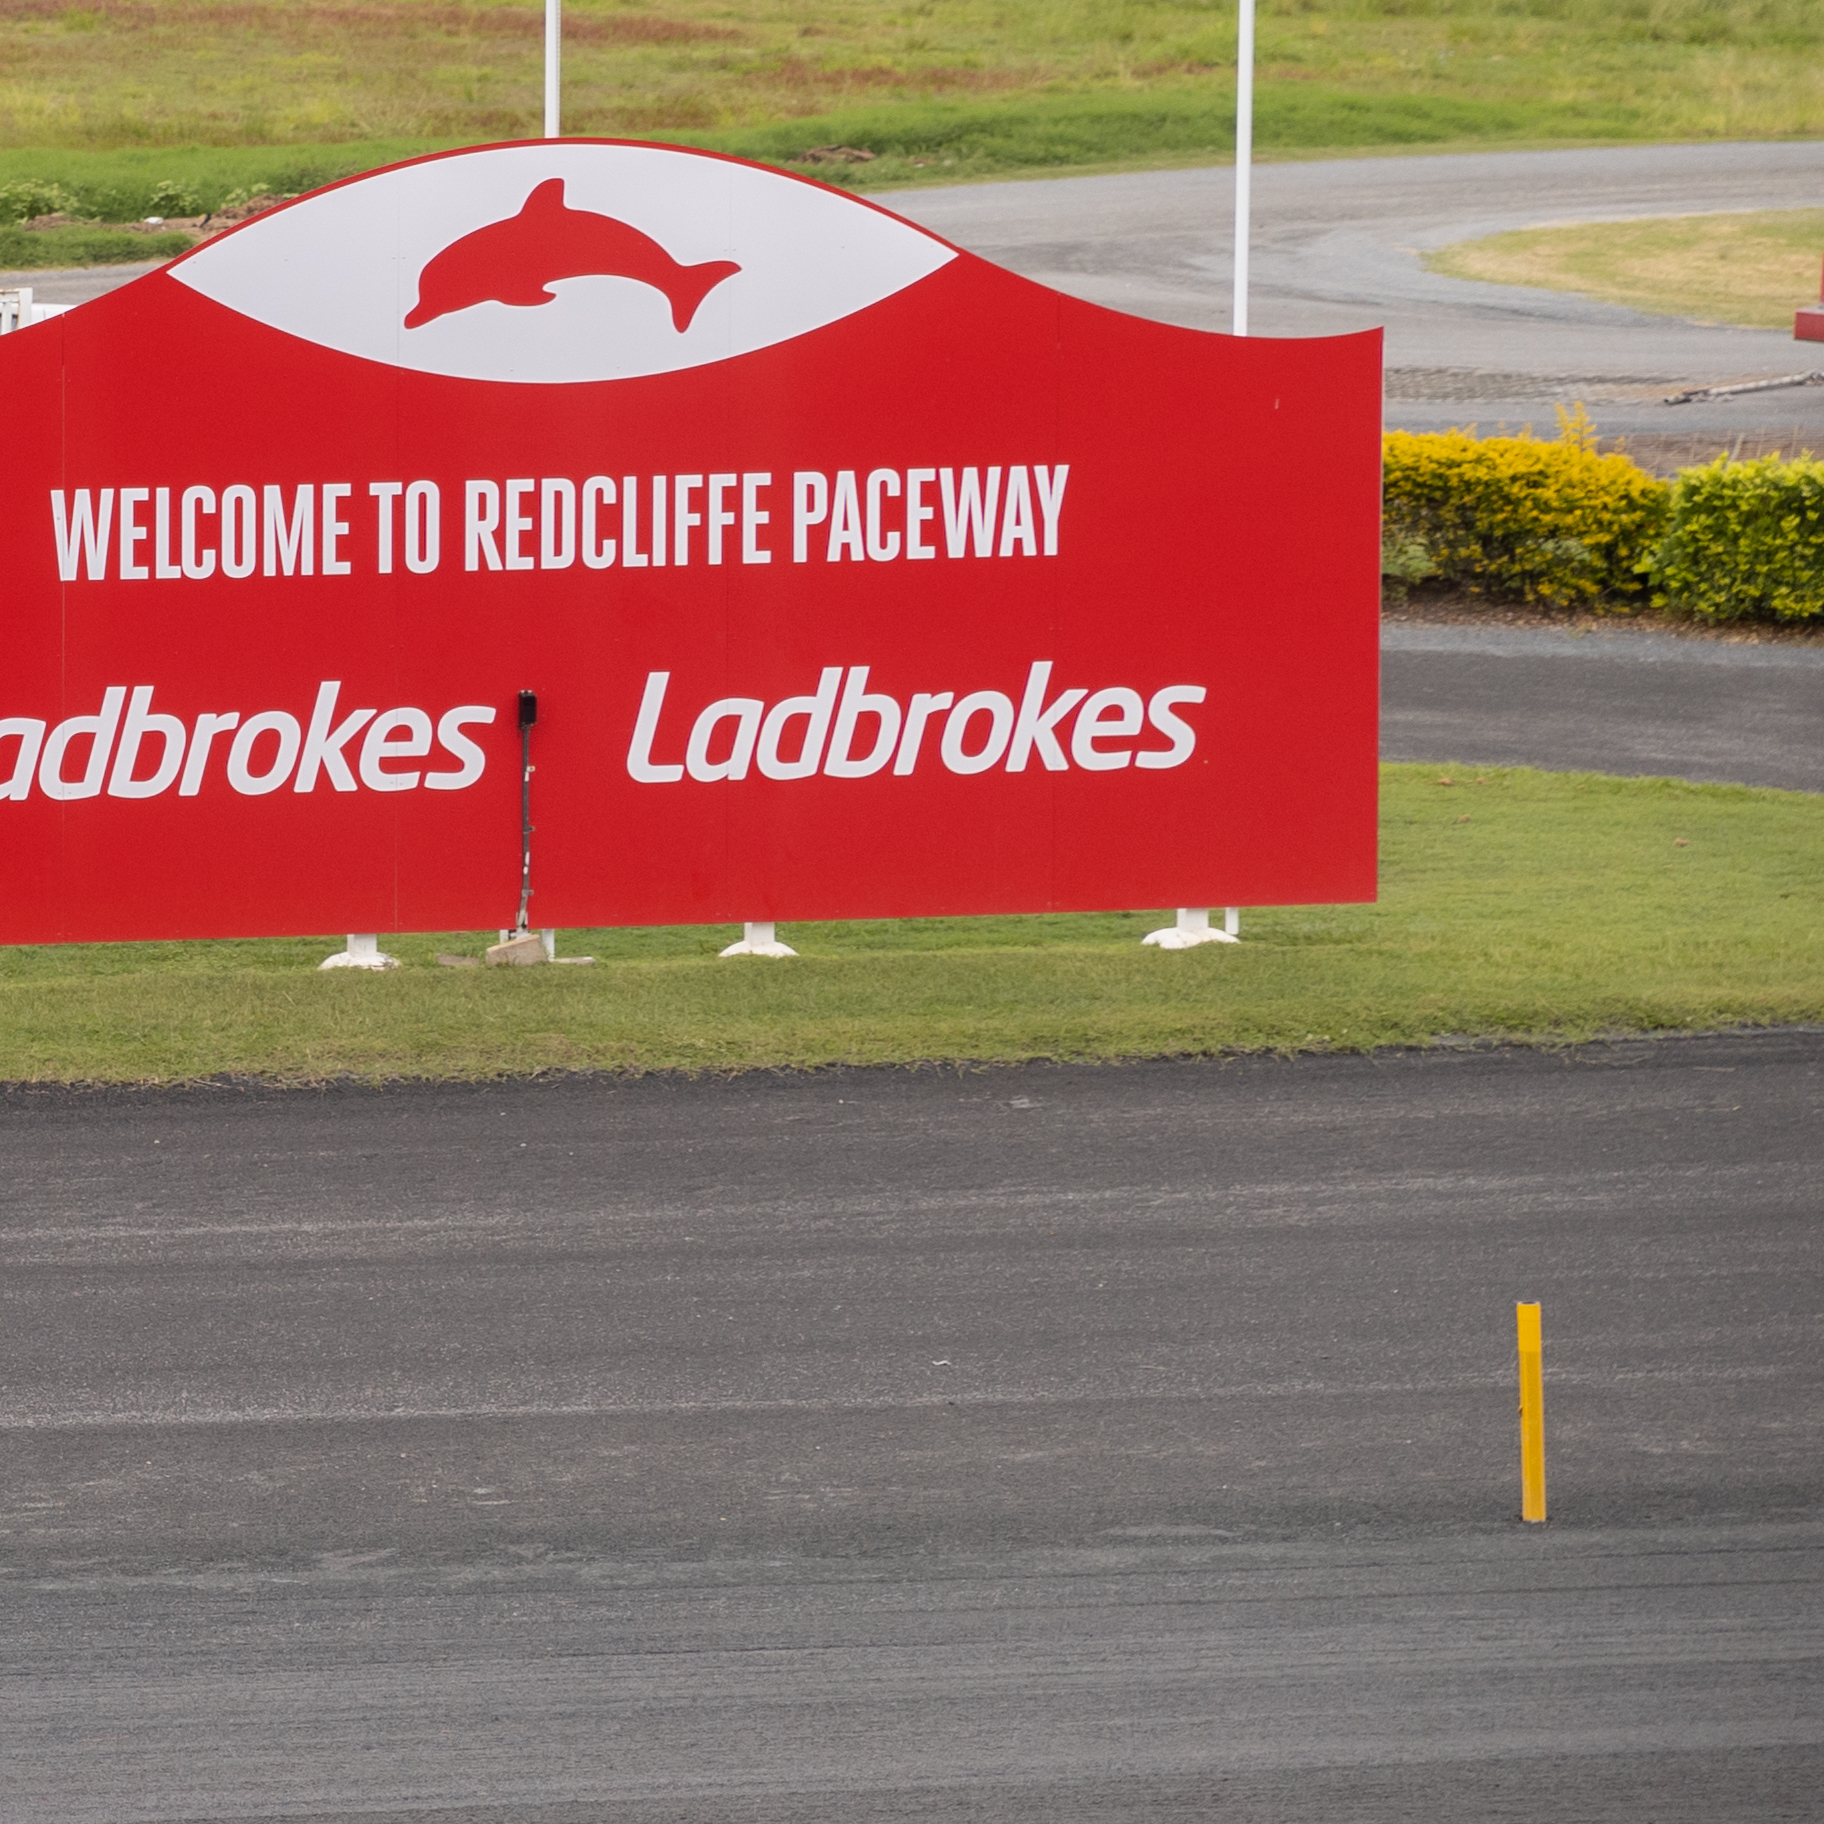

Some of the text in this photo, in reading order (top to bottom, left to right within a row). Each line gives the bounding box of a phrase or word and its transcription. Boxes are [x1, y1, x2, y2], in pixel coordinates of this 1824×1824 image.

[50, 464, 1070, 582] WELCOME TO REDCLIFFE PACEWAY
[626, 660, 1207, 784] Ladbrokes
